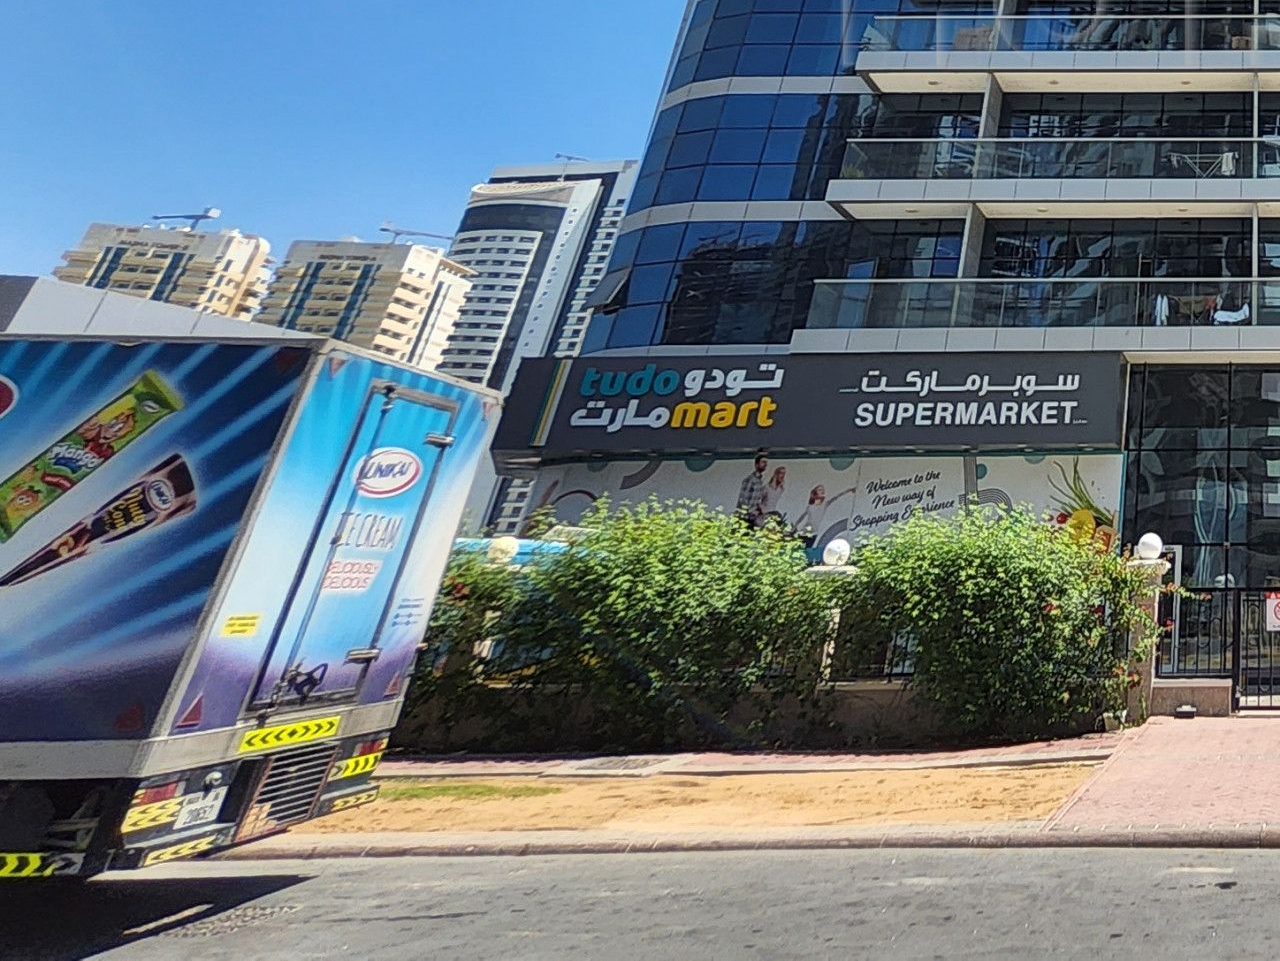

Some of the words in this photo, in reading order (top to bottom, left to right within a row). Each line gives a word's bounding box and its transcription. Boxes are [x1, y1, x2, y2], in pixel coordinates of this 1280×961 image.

[579, 364, 680, 396] tudo
[684, 364, 785, 397] تودو
[860, 370, 1081, 397] سوبرماركت
[570, 399, 671, 433] مارت
[670, 396, 778, 428] mart
[854, 401, 1078, 426] SUPERMARKET
[51, 443, 99, 468] Mango
[866, 478, 913, 495] Welcome
[913, 474, 924, 484] to
[925, 470, 941, 482] the
[872, 494, 901, 510] New
[902, 489, 925, 503] way
[926, 485, 937, 500] of
[849, 511, 899, 532] Shopping
[901, 499, 955, 521] Exerience
